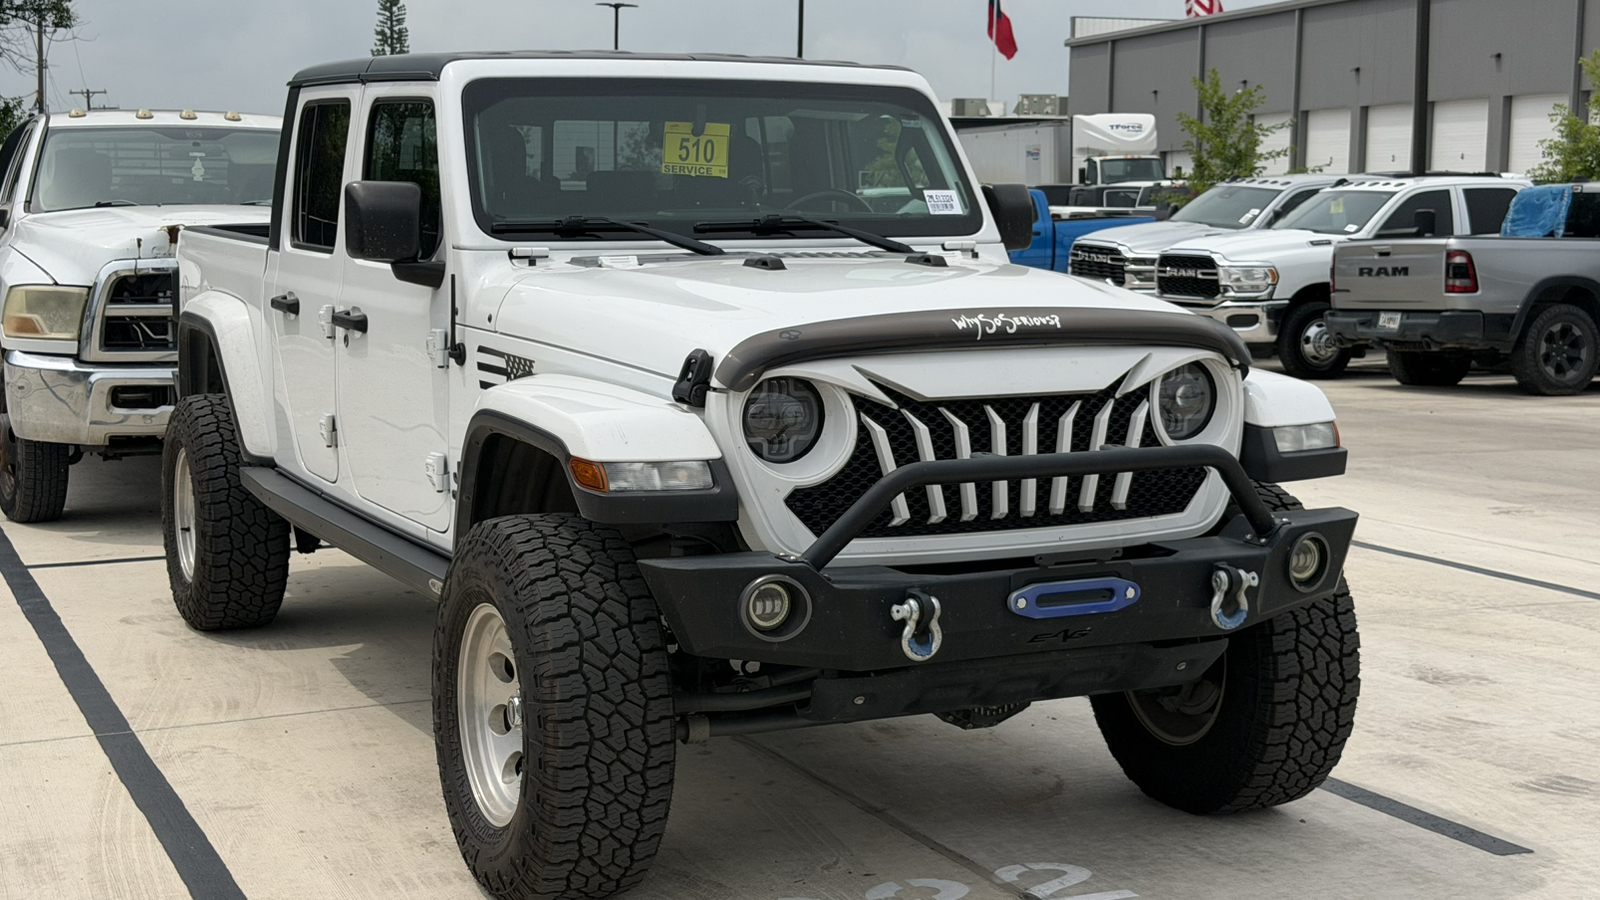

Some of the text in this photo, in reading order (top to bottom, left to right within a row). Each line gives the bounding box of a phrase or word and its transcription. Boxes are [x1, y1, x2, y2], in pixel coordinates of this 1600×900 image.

[678, 137, 715, 164] 510
[663, 164, 713, 176] SERVICE
[1169, 268, 1196, 277] RAM
[1358, 266, 1409, 277] RAM
